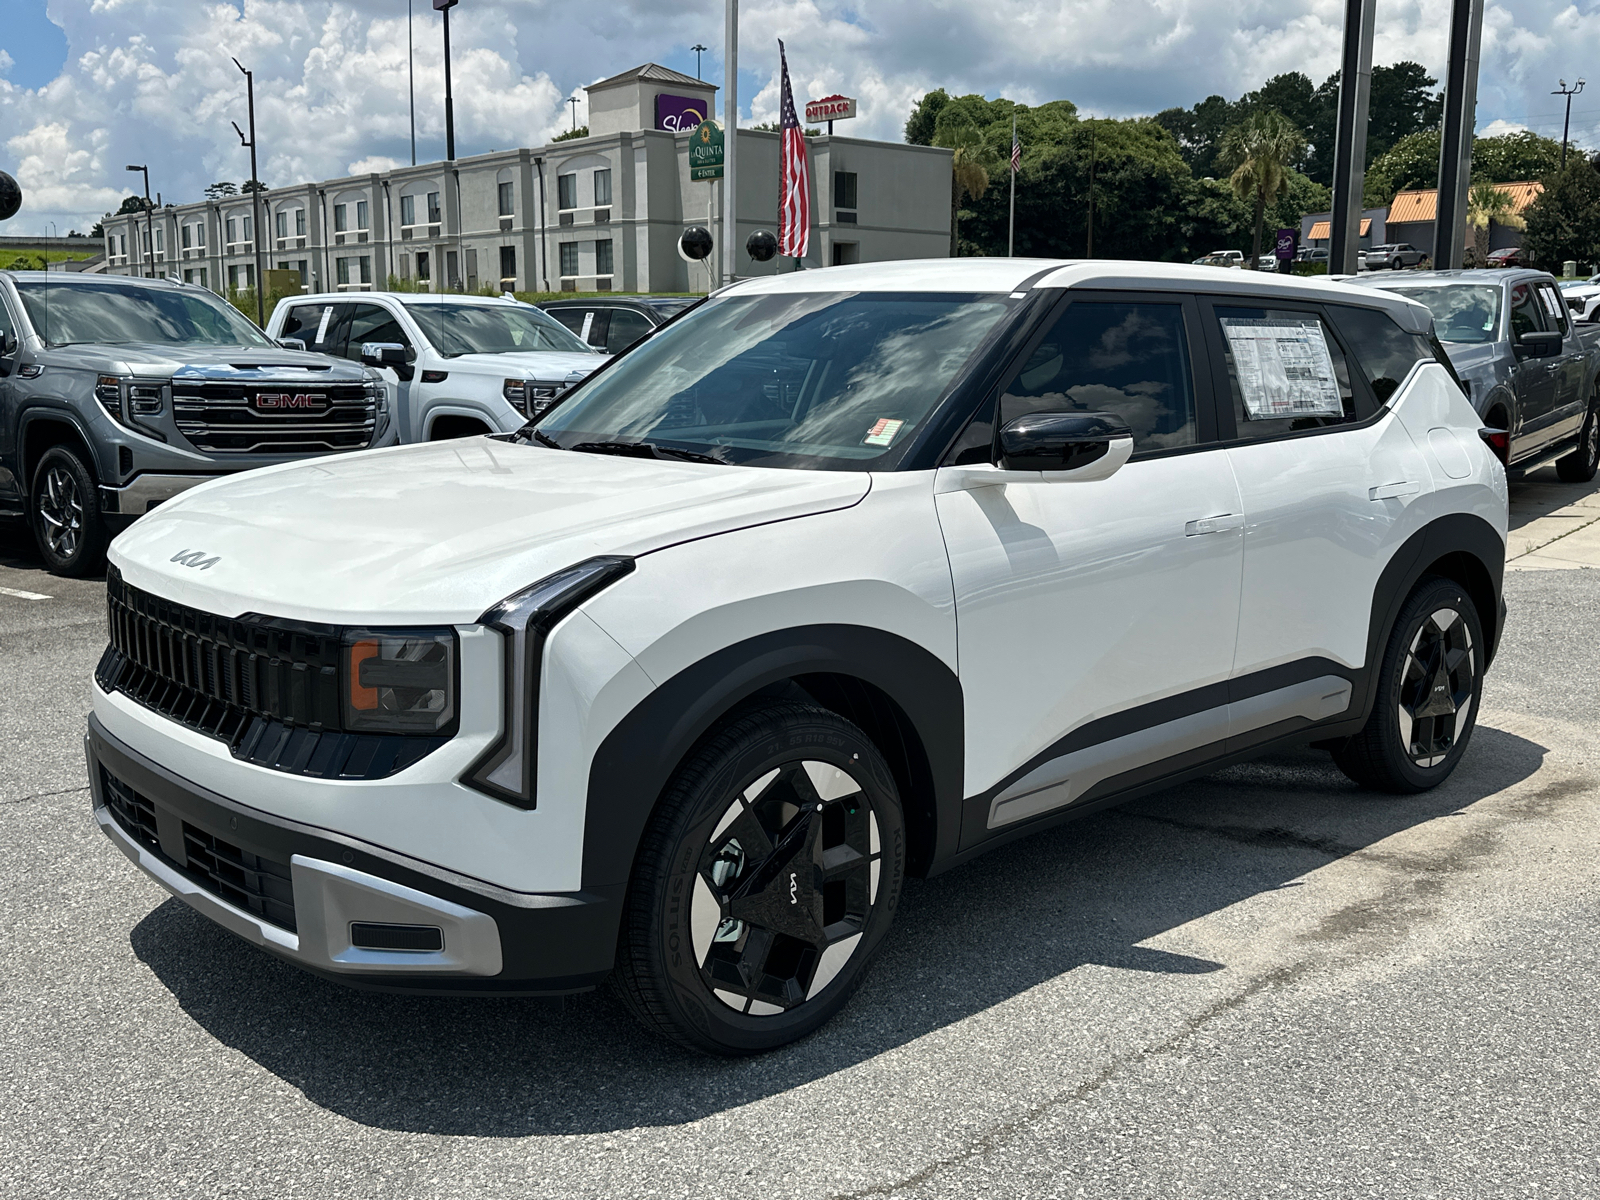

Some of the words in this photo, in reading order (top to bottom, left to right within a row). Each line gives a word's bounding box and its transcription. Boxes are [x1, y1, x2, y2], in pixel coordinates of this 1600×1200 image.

[805, 101, 849, 118] OUTBACK
[695, 145, 723, 160] QUINTA
[256, 393, 327, 409] GMC
[804, 734, 825, 743] R18
[826, 735, 846, 747] 95V
[887, 827, 902, 911] KUMHO
[668, 877, 684, 968] SOLUS
